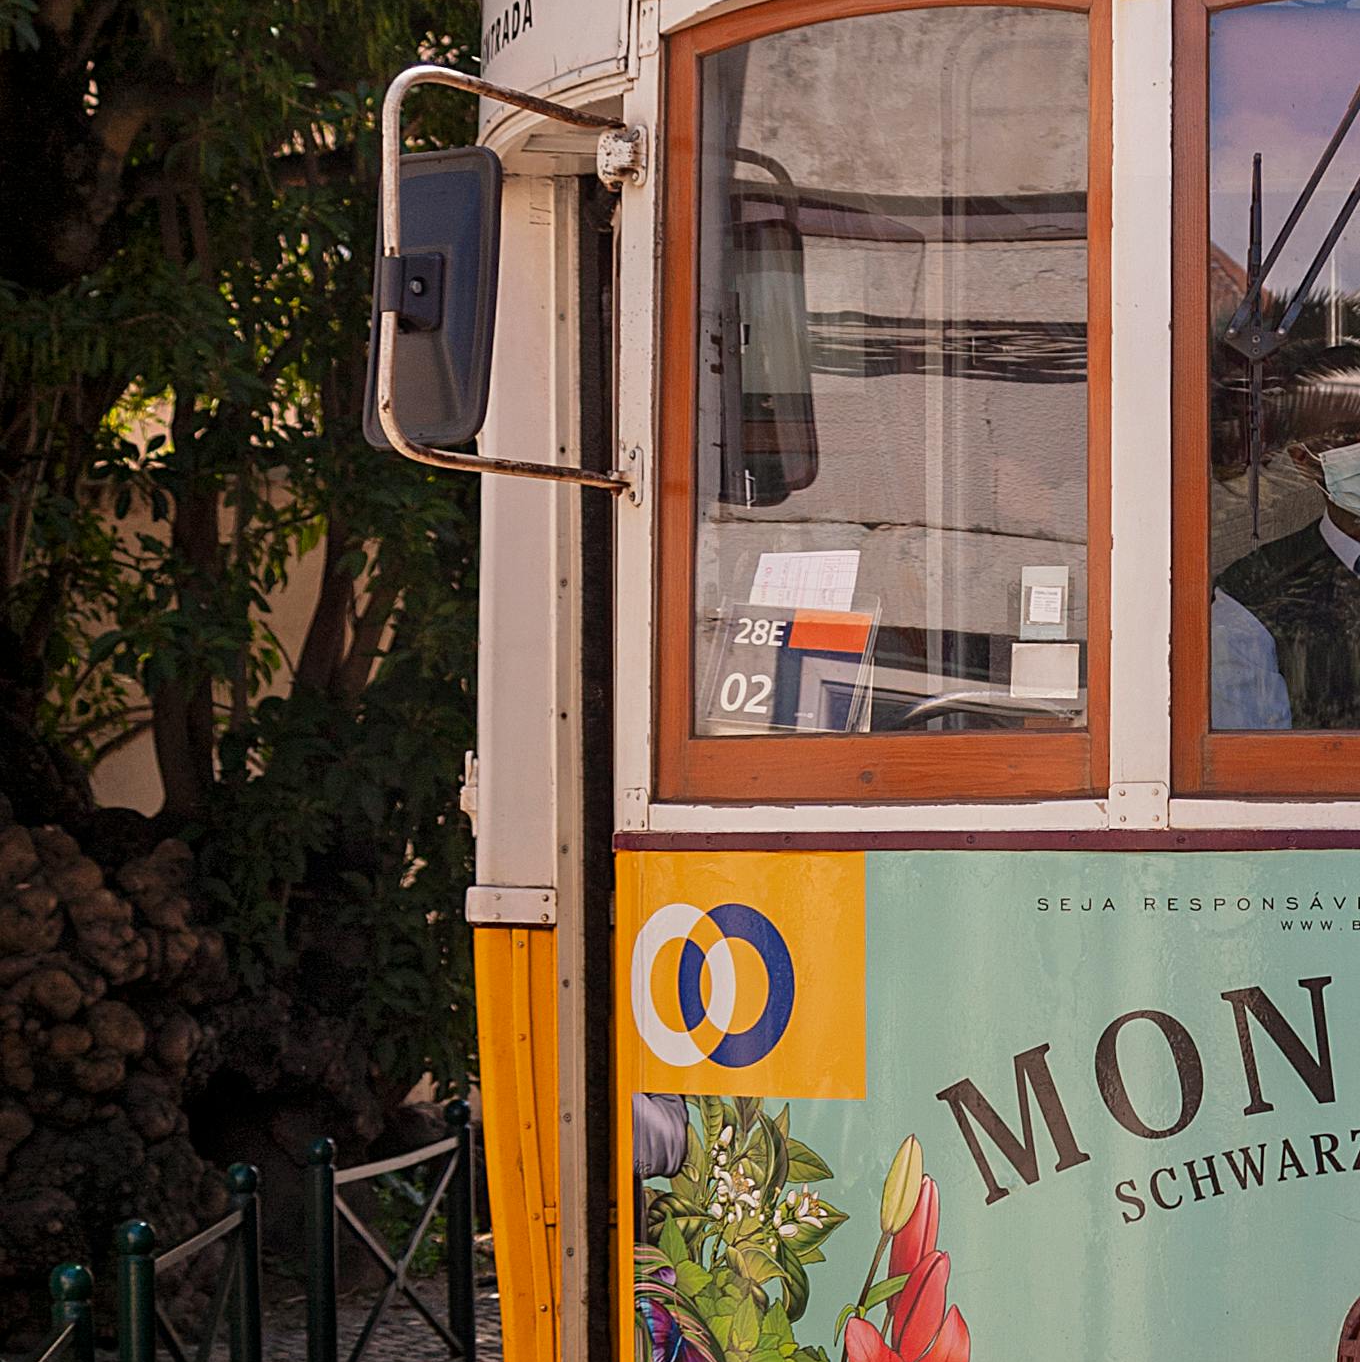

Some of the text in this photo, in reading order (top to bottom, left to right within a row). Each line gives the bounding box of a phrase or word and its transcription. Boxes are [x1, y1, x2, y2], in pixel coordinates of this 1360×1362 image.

[734, 617, 788, 648] 28E
[720, 671, 773, 714] 02
[1036, 897, 1116, 912] SEJA
